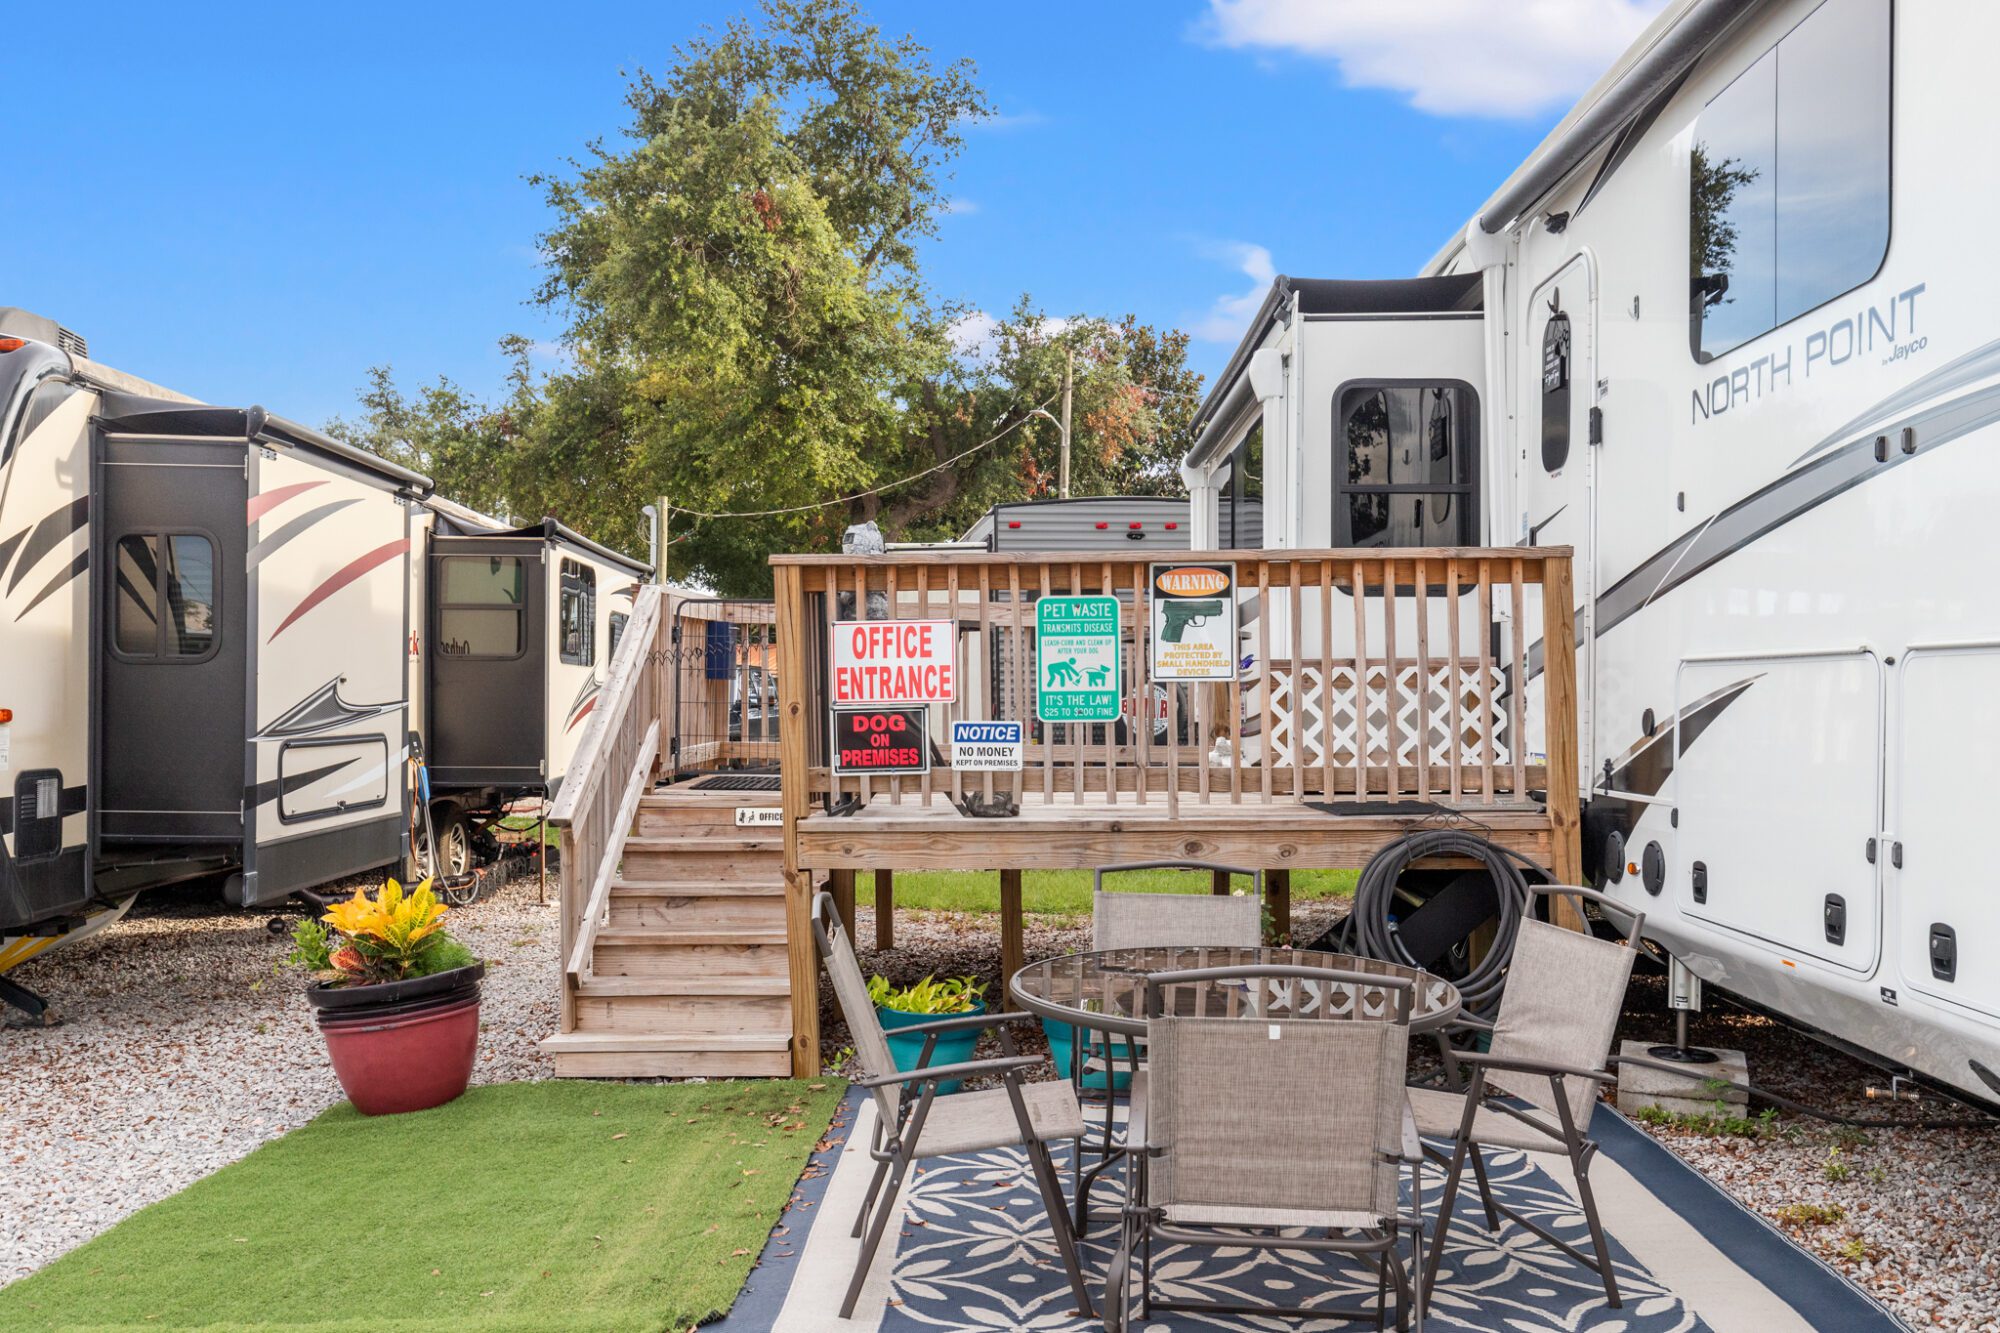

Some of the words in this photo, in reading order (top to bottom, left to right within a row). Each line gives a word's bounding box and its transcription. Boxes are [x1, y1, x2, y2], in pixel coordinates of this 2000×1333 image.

[1692, 345, 1792, 425] NORTH
[1806, 282, 1926, 378] POINT
[1889, 336, 1928, 362] Jayco
[1161, 574, 1225, 591] WARNING
[1043, 603, 1067, 617] PET
[1071, 602, 1112, 617] WASTE
[1043, 623, 1081, 633] TRANSMITS
[1084, 622, 1113, 633] DISEASE
[852, 625, 932, 660] OFFICE
[1172, 643, 1191, 651] THIS
[1192, 643, 1214, 651] AREA
[1164, 651, 1210, 659] PROTECTED
[1212, 651, 1223, 659] BY
[1157, 660, 1184, 668] SMALL
[1176, 668, 1211, 676] DEVICES
[836, 664, 952, 700] ENTRANCE
[1045, 695, 1064, 706] IT'S
[1067, 694, 1087, 706] THE
[1090, 694, 1112, 706] LAW!
[1044, 708, 1059, 717] $25
[1062, 708, 1071, 717] TO
[1097, 707, 1114, 716] FINE
[852, 714, 907, 733] DOG
[957, 726, 1018, 740] NOTICE
[870, 733, 890, 748] ON
[841, 747, 920, 767] PREMISES
[959, 746, 974, 757] NO
[976, 746, 1014, 757] MONEY
[956, 759, 972, 767] KEPT
[984, 759, 1018, 767] PREMISES
[759, 812, 783, 821] OFFICE
